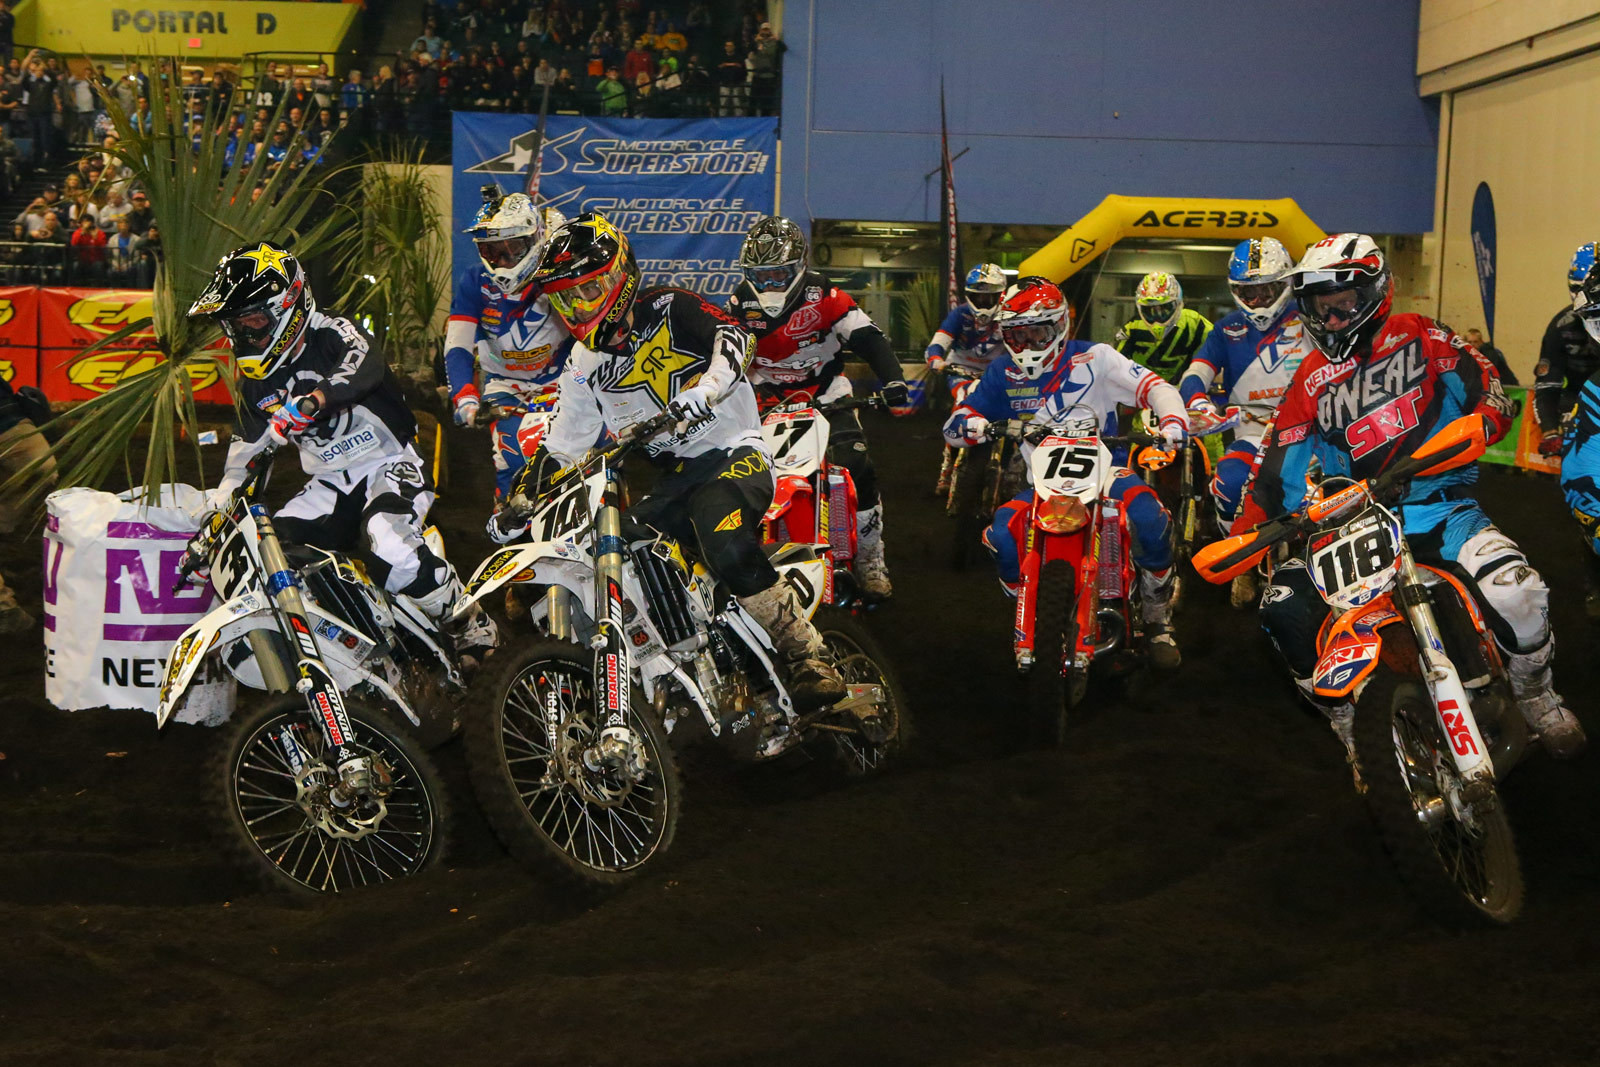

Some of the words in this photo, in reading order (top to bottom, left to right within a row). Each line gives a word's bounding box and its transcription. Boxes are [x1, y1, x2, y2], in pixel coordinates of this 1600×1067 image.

[111, 9, 228, 35] PORTAL
[256, 12, 278, 35] D
[572, 138, 763, 175] SUPERSTORE
[617, 139, 746, 151] MOTORCYCLE
[617, 198, 744, 210] MOTORCYCLE
[1132, 210, 1280, 228] ACERBIS
[634, 259, 742, 271] OTORCYCLE
[640, 271, 747, 295] ERSTOR
[1249, 387, 1285, 401] MAXX
[1304, 357, 1357, 397] KENDA
[658, 411, 718, 449] Husarna
[773, 419, 815, 460] 7
[1345, 386, 1423, 461] SRT
[1043, 446, 1099, 480] 15
[1318, 527, 1394, 597] 118
[606, 653, 619, 711] BRAKING
[618, 648, 629, 713] DUNLOP
[316, 691, 345, 746] BRAKING
[325, 683, 354, 743] DUNLOP
